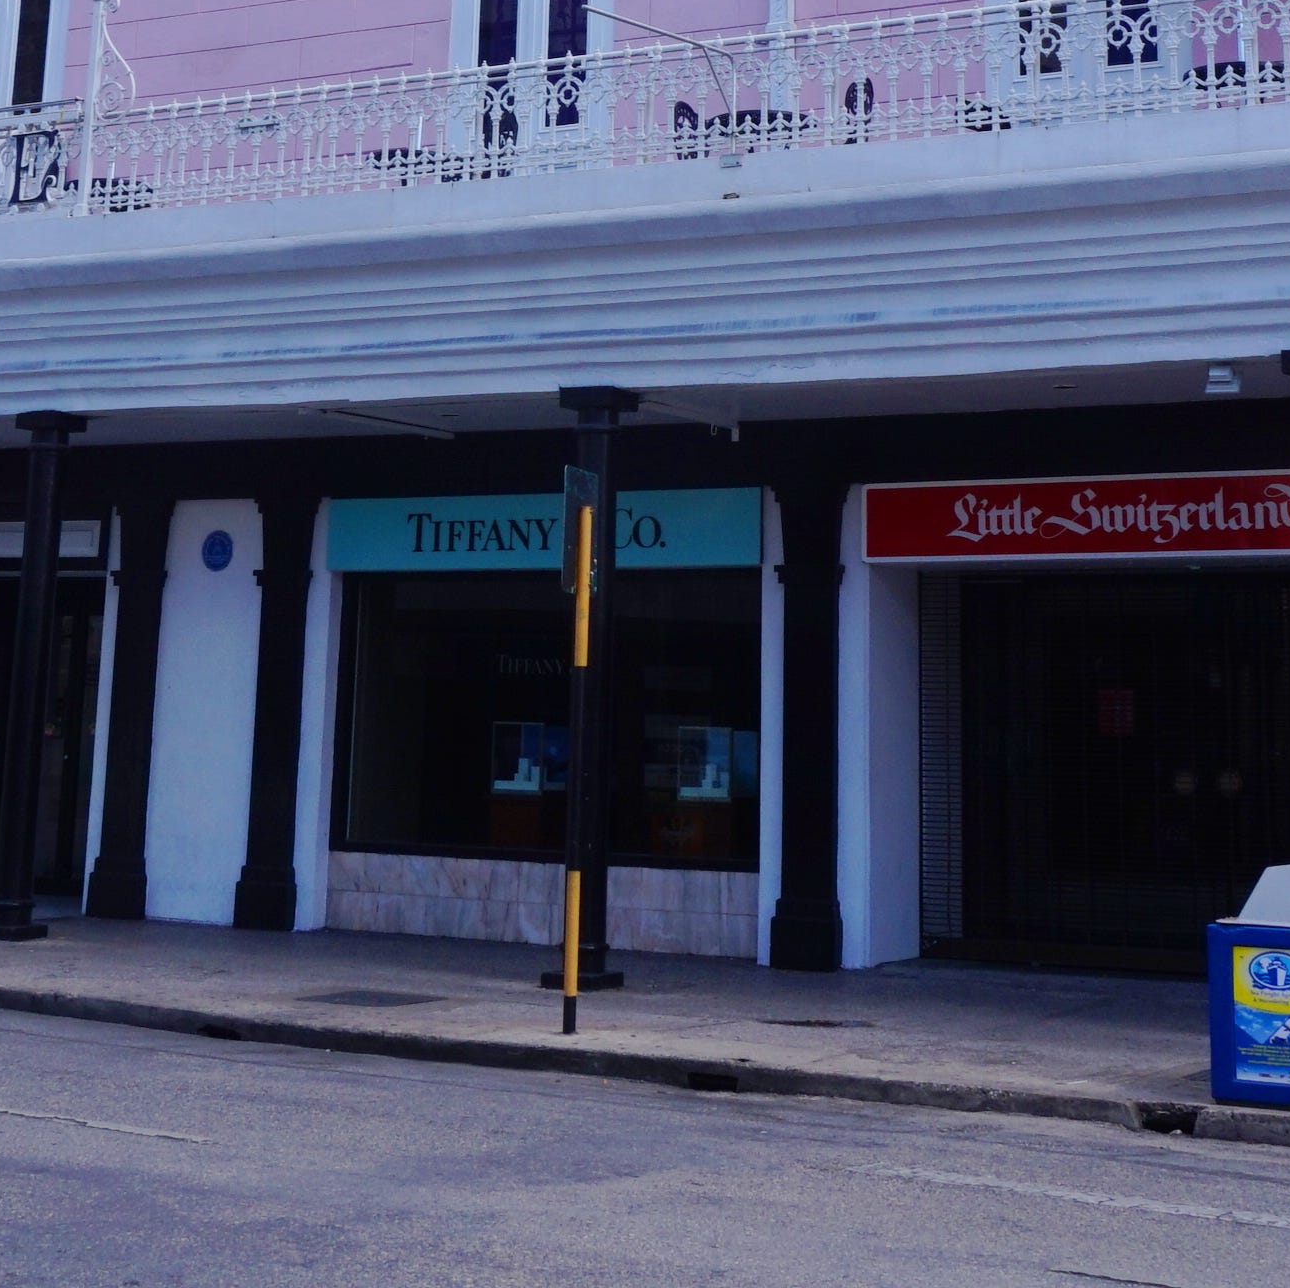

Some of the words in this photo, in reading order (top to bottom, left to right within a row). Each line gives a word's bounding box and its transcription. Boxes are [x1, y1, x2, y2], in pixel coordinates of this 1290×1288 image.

[407, 513, 559, 552] TIFFANY
[945, 492, 1043, 542] Little
[496, 653, 566, 674] TIFFANY
